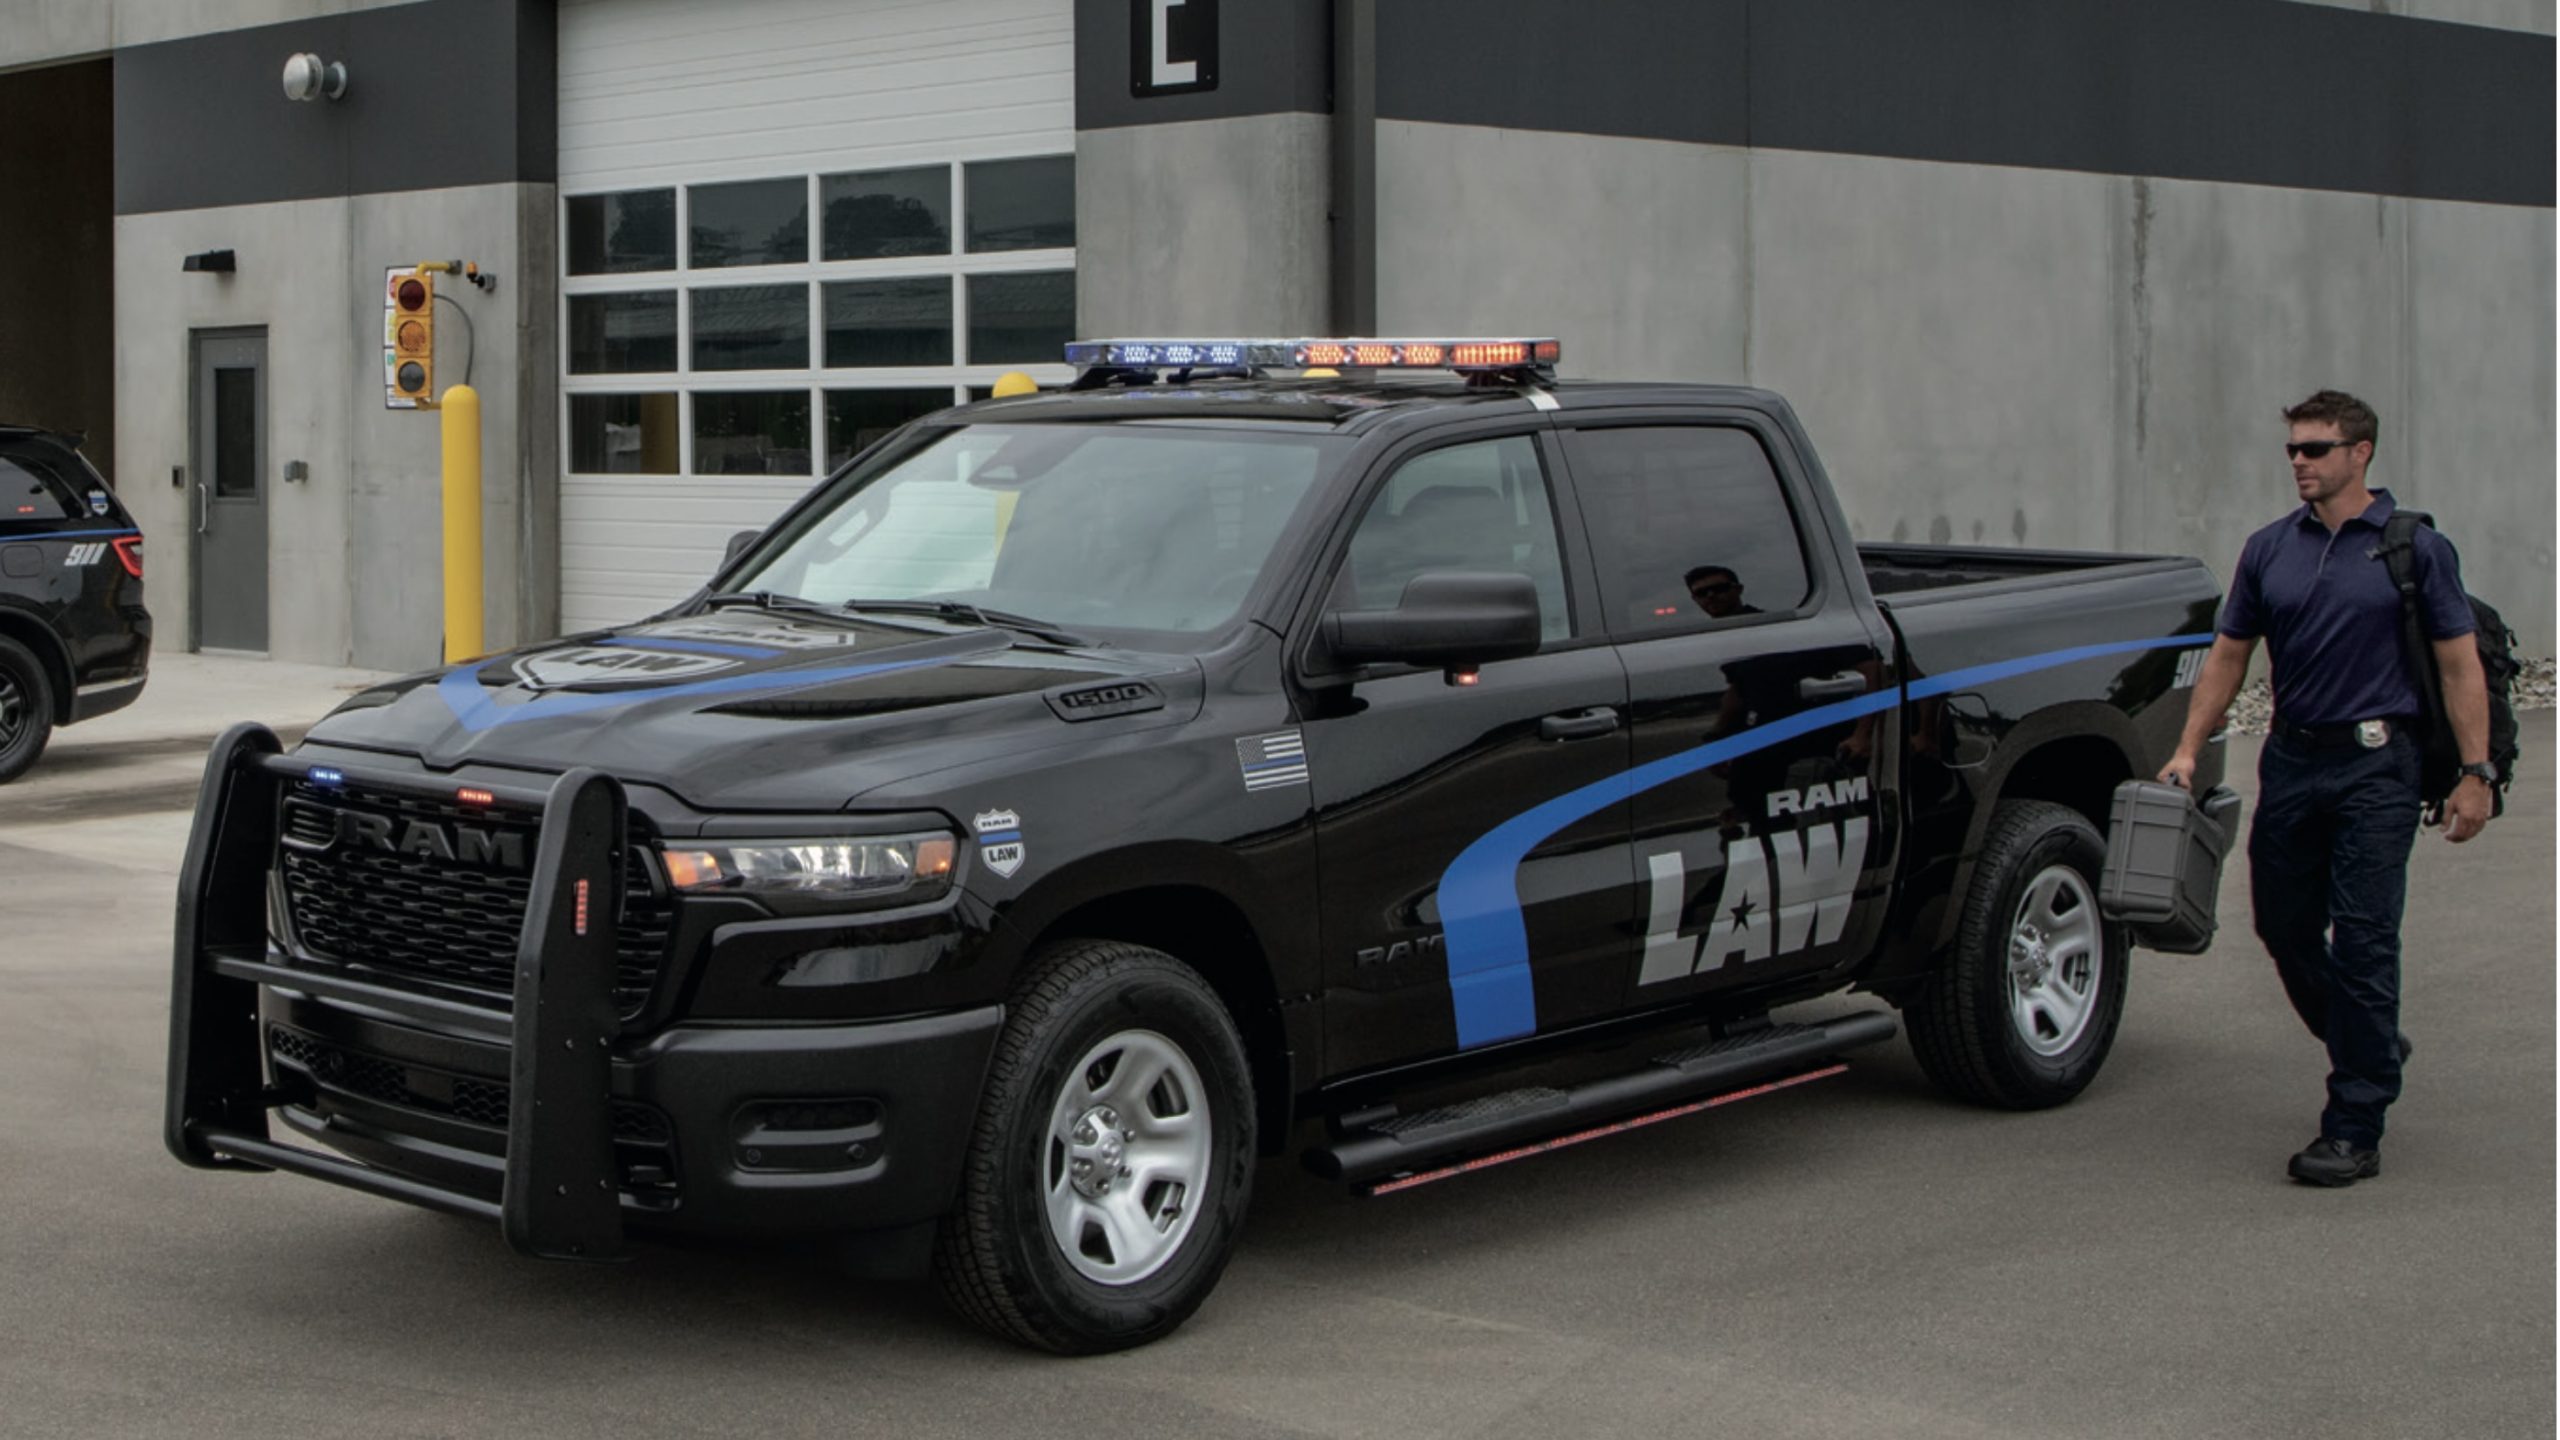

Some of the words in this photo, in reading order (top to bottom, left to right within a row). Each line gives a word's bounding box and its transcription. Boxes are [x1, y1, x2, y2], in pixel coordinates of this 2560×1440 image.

[64, 542, 108, 566] 911
[541, 650, 708, 672] LAW
[1060, 684, 1144, 708] 1500
[1767, 776, 1870, 818] RAM
[335, 808, 527, 869] RAM
[988, 845, 1018, 863] LAW
[1637, 815, 1870, 986] LAW
